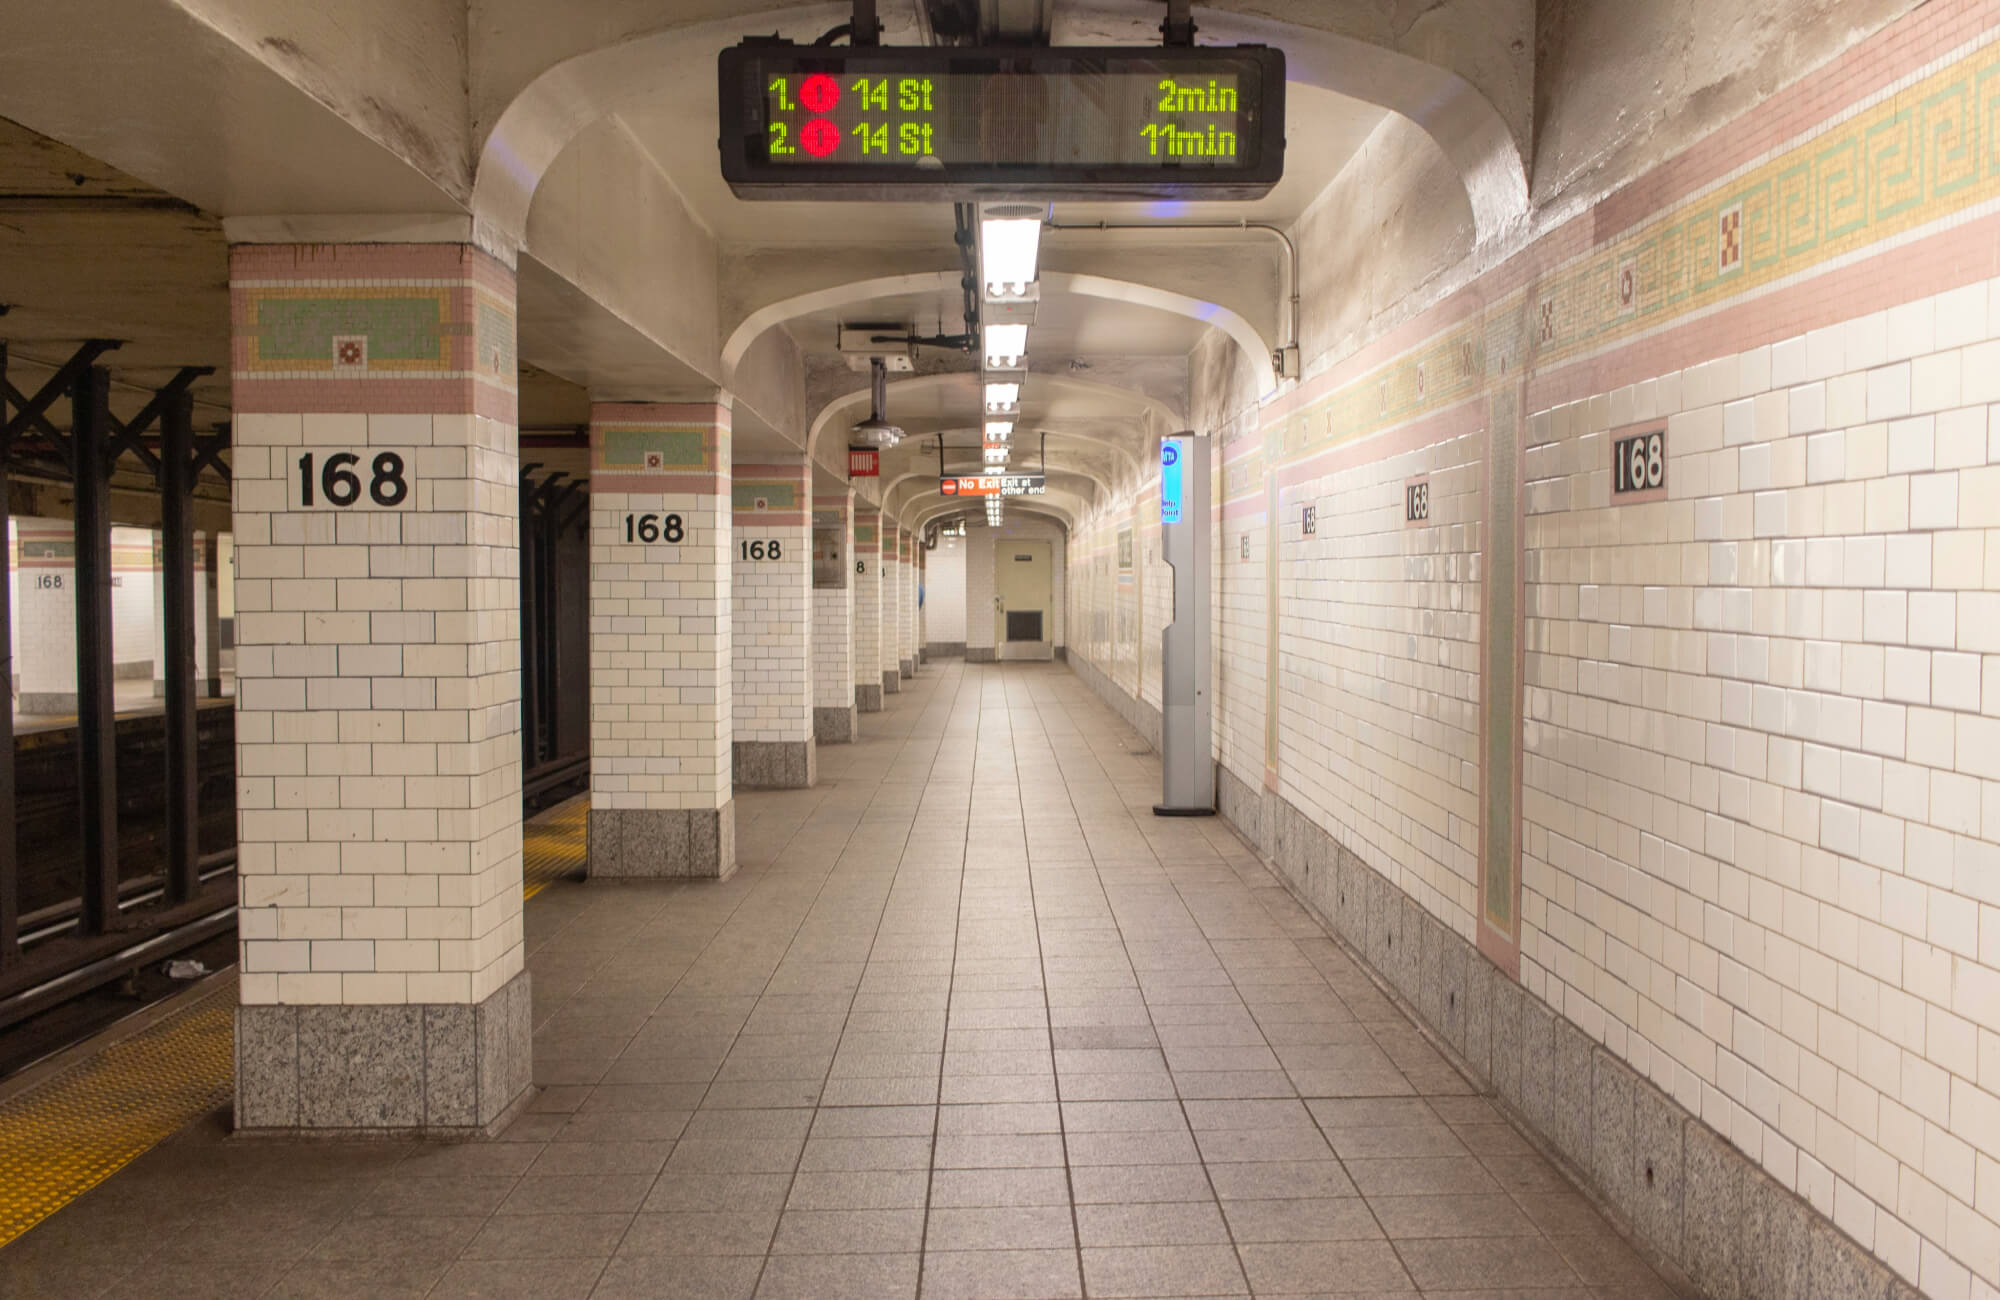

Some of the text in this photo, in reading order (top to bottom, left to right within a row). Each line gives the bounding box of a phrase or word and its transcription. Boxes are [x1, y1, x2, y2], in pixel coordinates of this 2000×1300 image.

[769, 78, 795, 111] 1.
[851, 78, 888, 111] 14
[899, 79, 933, 111] St
[1158, 79, 1237, 113] 2min
[770, 122, 795, 154] 2.
[852, 122, 888, 155] 14
[899, 122, 933, 155] St
[1139, 123, 1236, 156] 11min
[1619, 434, 1662, 490] 168
[298, 451, 408, 507] 168
[959, 478, 1000, 489] No Exit
[1001, 478, 1018, 488] Exit
[1001, 485, 1045, 496] other end
[1408, 484, 1428, 520] 168
[625, 513, 684, 543] 168
[741, 540, 782, 561] 168
[37, 575, 63, 589] 168
